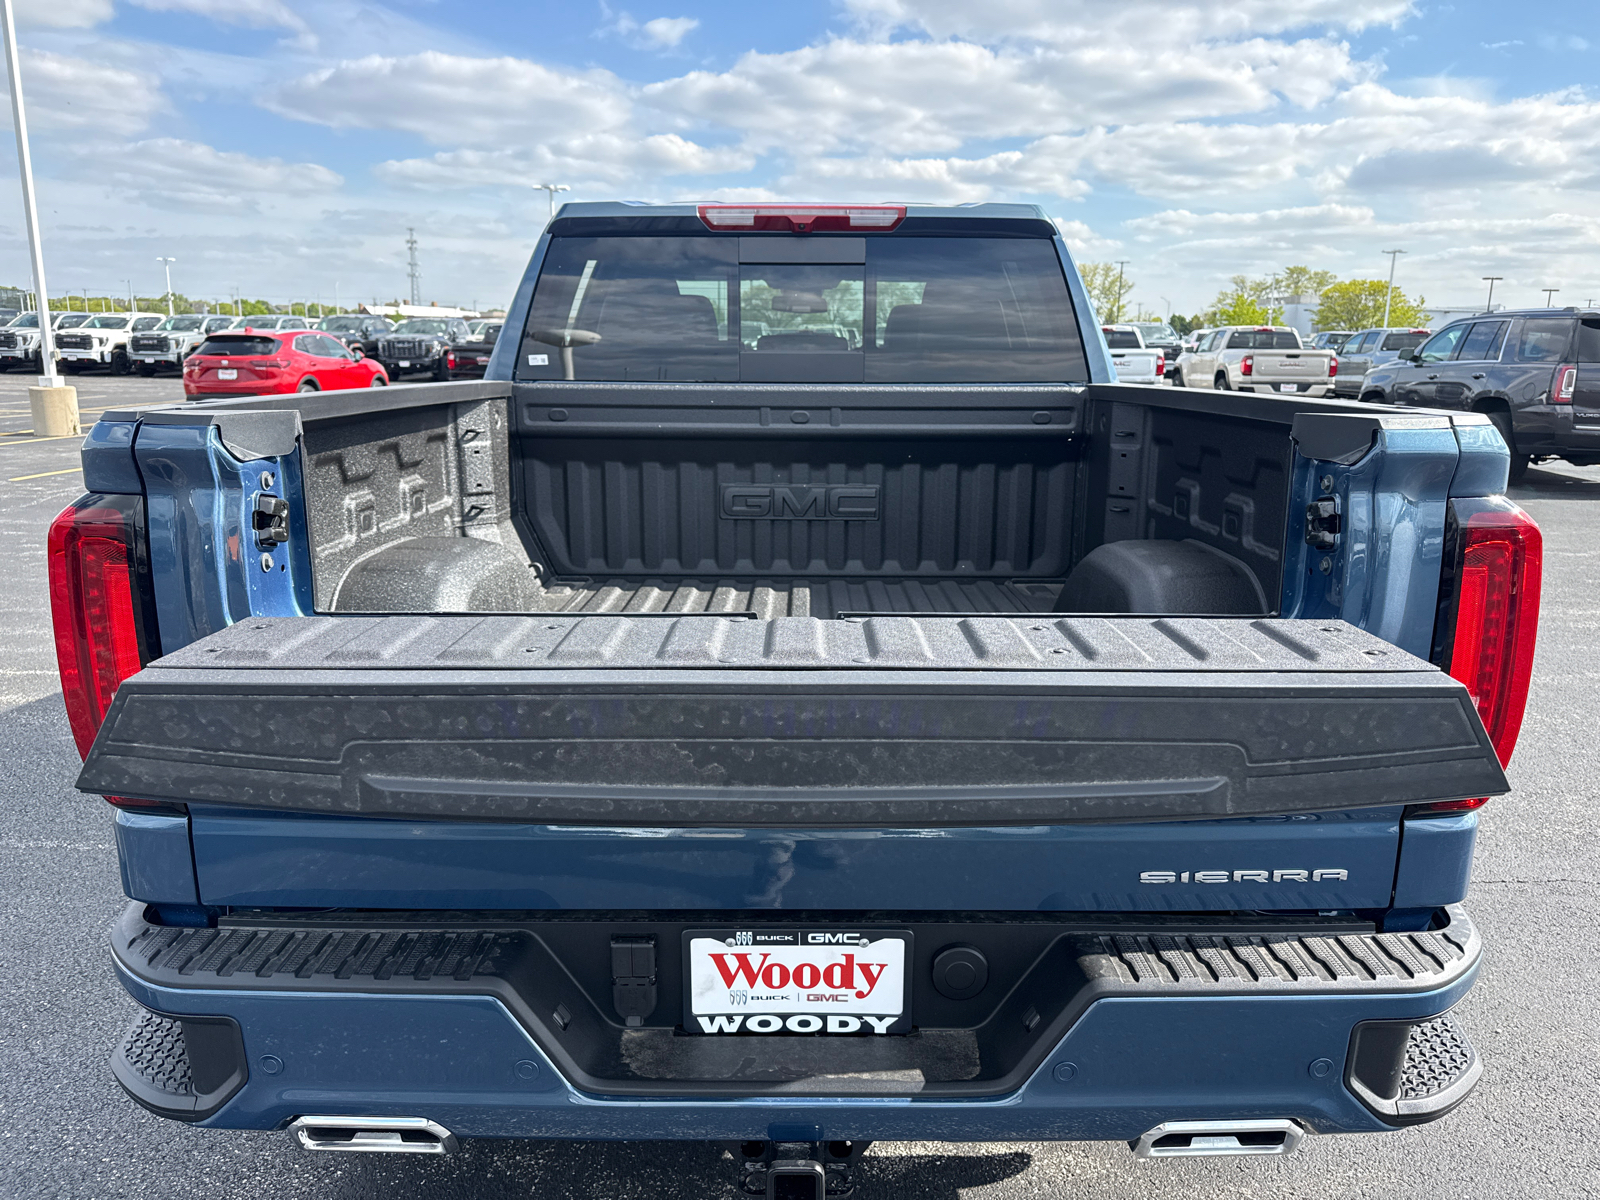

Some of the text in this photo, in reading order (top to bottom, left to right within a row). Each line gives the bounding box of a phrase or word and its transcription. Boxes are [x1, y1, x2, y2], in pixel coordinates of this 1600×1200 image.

[723, 487, 877, 518] GMC
[1139, 869, 1349, 884] SIERRA
[807, 933, 860, 944] GMC
[708, 953, 888, 999] Woody
[806, 993, 848, 1002] GMC
[697, 1015, 898, 1034] WOODY
